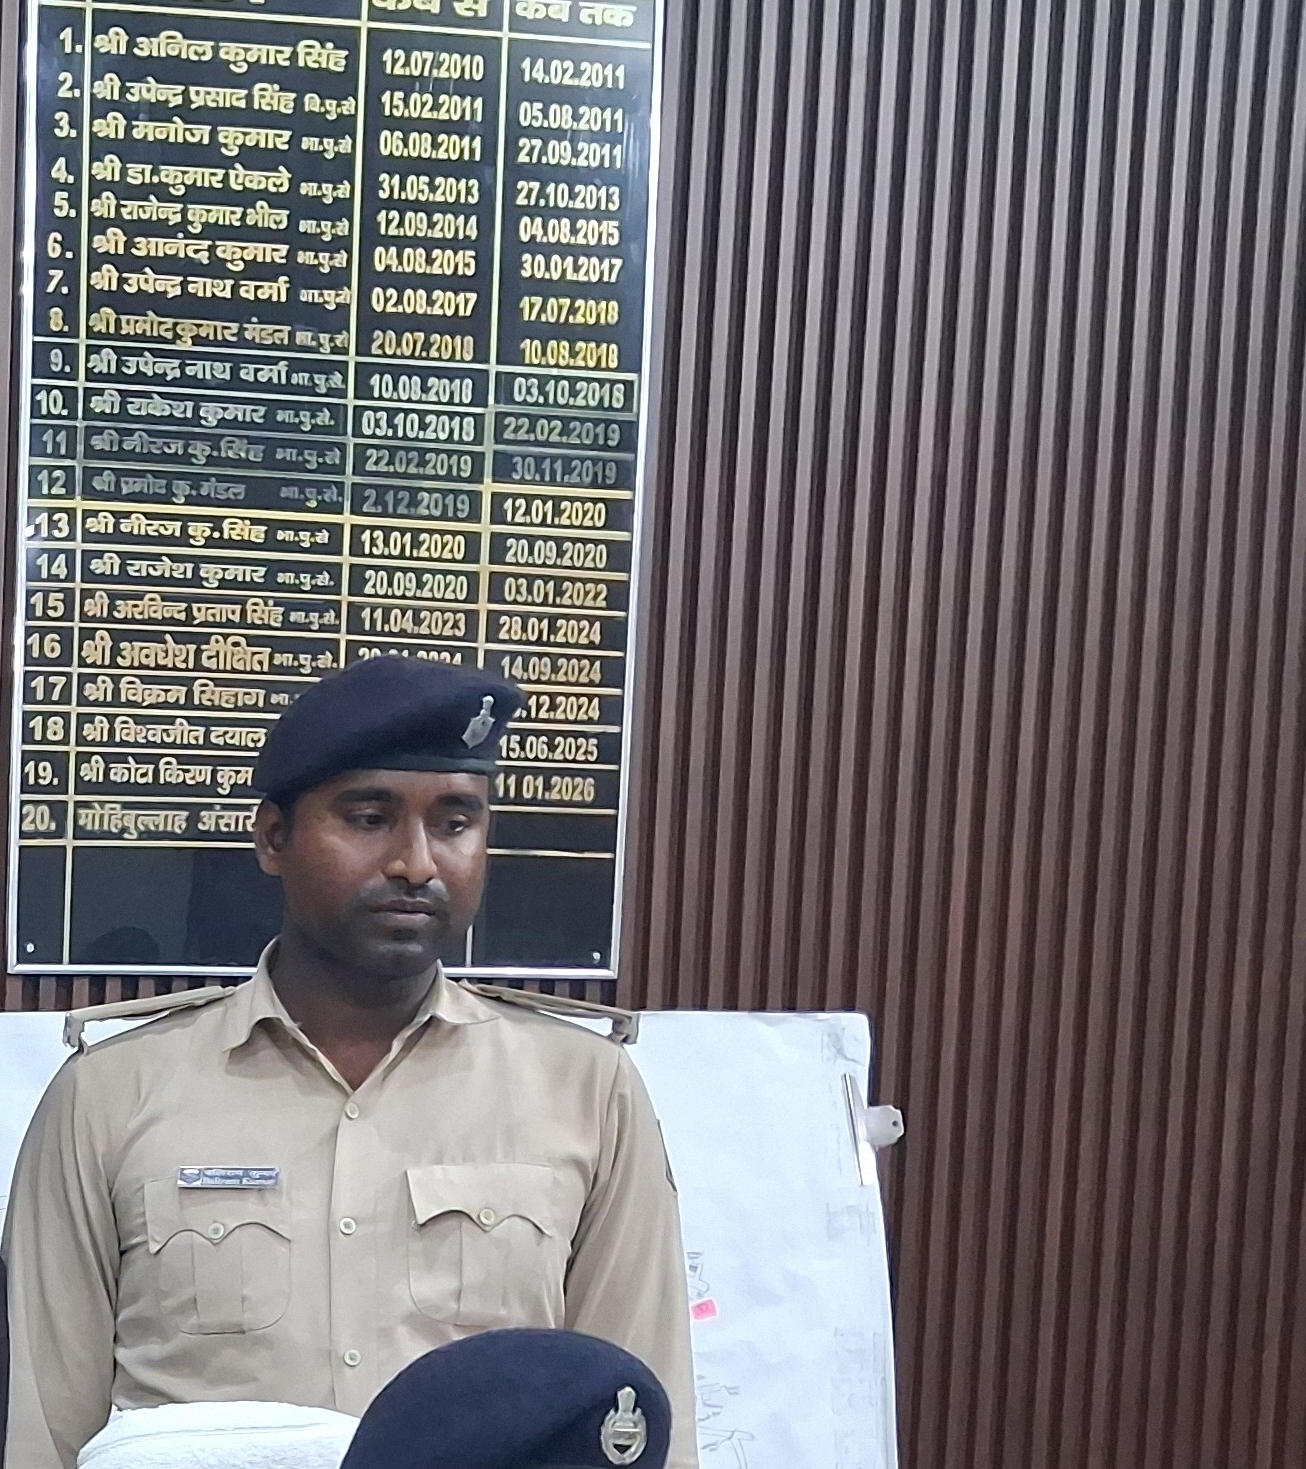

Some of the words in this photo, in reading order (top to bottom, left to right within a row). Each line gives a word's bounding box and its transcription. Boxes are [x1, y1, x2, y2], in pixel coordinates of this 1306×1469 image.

[515, 0, 572, 22] कब
[579, 2, 637, 27] तक
[59, 27, 83, 53] 1.
[93, 26, 129, 55] श्री
[133, 30, 214, 61] अनिल
[219, 43, 293, 74] कुमार
[296, 40, 349, 72] सिंह
[382, 48, 484, 81] 12.07.2010
[520, 57, 625, 90] 14.02.2011
[57, 71, 80, 98] 2.
[92, 73, 121, 101] श्री
[125, 76, 185, 108] उपेन्द्र
[189, 84, 248, 110] प्रसाद
[253, 82, 297, 114] सिंह
[381, 90, 483, 123] 15.02.2011
[518, 100, 624, 133] 05.08.2011
[53, 111, 77, 138] 3.
[92, 111, 127, 140] श्री
[131, 116, 212, 144] मनोज
[217, 125, 292, 157] कुमार
[379, 129, 482, 161] 06.08.2011
[517, 137, 622, 169] 27.09.2011
[50, 156, 75, 184] 4.
[90, 153, 122, 182] श्री
[228, 163, 292, 194] ऐकले
[378, 172, 480, 205] 31.05.2013
[516, 179, 620, 212] 27.10.2013
[53, 191, 77, 217] 5.
[90, 191, 117, 219] श्री
[120, 193, 183, 225] राजेन्द्र
[187, 203, 243, 234] कुमार
[246, 199, 290, 230] भील
[376, 208, 478, 241] 12.09.2014
[519, 215, 620, 247] 04.08.2015
[47, 232, 74, 259] 6.
[92, 227, 127, 256] श्री
[130, 232, 213, 265] आनंद
[215, 241, 290, 271] कुमार
[374, 245, 476, 277] 04.08.2015
[520, 253, 623, 284] 30.01.2017
[45, 269, 69, 295] 7.
[89, 264, 120, 292] श्री
[121, 266, 184, 300] उपेन्द्र
[187, 276, 235, 300] नाथ
[239, 275, 290, 304] वर्मा
[371, 286, 478, 317] 02.08.2017
[519, 295, 620, 326] 17.07.2018
[49, 306, 69, 332] 8.
[88, 306, 116, 335] श्री
[243, 317, 291, 346] मंडल
[371, 329, 475, 361] 20.07.2018
[520, 338, 619, 369] 10.08.2018
[49, 348, 71, 373] 9.
[88, 347, 117, 375] श्री
[121, 351, 182, 382] उपेन्द्र
[185, 360, 233, 382] नाथ
[239, 361, 288, 386] वर्मा
[370, 373, 474, 404] 10.08.2018
[513, 376, 625, 410] 03.10.2018
[36, 389, 68, 416] 10.
[89, 389, 121, 415] श्री
[126, 393, 194, 419] राकेश
[199, 401, 268, 428] कुमार
[361, 410, 475, 443] 03.10.2018
[503, 416, 621, 448] 22.02.2019
[41, 429, 67, 455] 11
[90, 429, 120, 452] श्री
[122, 430, 184, 456] नीरज
[365, 448, 473, 478] 22.02.2019
[511, 455, 617, 485] 30.11.2019
[37, 469, 67, 495] 12
[91, 470, 116, 494] श्री
[120, 474, 167, 496] प्रमोद
[363, 488, 470, 518] 2.12.2019
[503, 497, 606, 528] 12.01.2020
[34, 512, 70, 538] 13
[85, 512, 115, 536] श्री
[119, 512, 182, 538] नीरज
[361, 528, 466, 561] 13.01.2020
[505, 537, 607, 570] 20.09.2020
[37, 552, 69, 580] 14
[89, 552, 120, 577] श्री
[126, 556, 193, 579] राजेश
[199, 564, 267, 588] कुमार
[364, 569, 468, 601] 20.09.2020
[504, 576, 607, 608] 03.01.2022
[30, 591, 65, 618] 15
[84, 591, 110, 620] श्री
[112, 593, 187, 622] अरविन्द
[191, 602, 242, 624] प्रताप
[246, 597, 285, 625] सिंह
[361, 607, 466, 637] 11.04.2023
[498, 615, 602, 646] 28.01.2024
[26, 632, 62, 659] 16
[81, 628, 113, 666] श्री
[116, 633, 196, 669] अवधेश
[200, 635, 272, 673] दीक्षित
[501, 655, 602, 685] 14.09.2024
[30, 676, 67, 701] 17
[83, 675, 114, 702] श्री
[119, 676, 187, 707] विक्रम
[193, 678, 267, 708] सिहाग
[512, 694, 600, 721] .12.2024
[29, 715, 64, 741] 18
[82, 714, 110, 743] श्री
[114, 716, 206, 746] विश्वजीत
[209, 728, 268, 748] दयाल
[499, 734, 598, 762] 15.06.2025
[24, 761, 59, 786] 19.
[79, 754, 105, 783] श्री
[109, 756, 154, 784] कोटा
[158, 756, 212, 785] किरण
[216, 766, 254, 795] कुम
[21, 804, 56, 831] 20.
[77, 804, 189, 839] मोहिबुल्लाह
